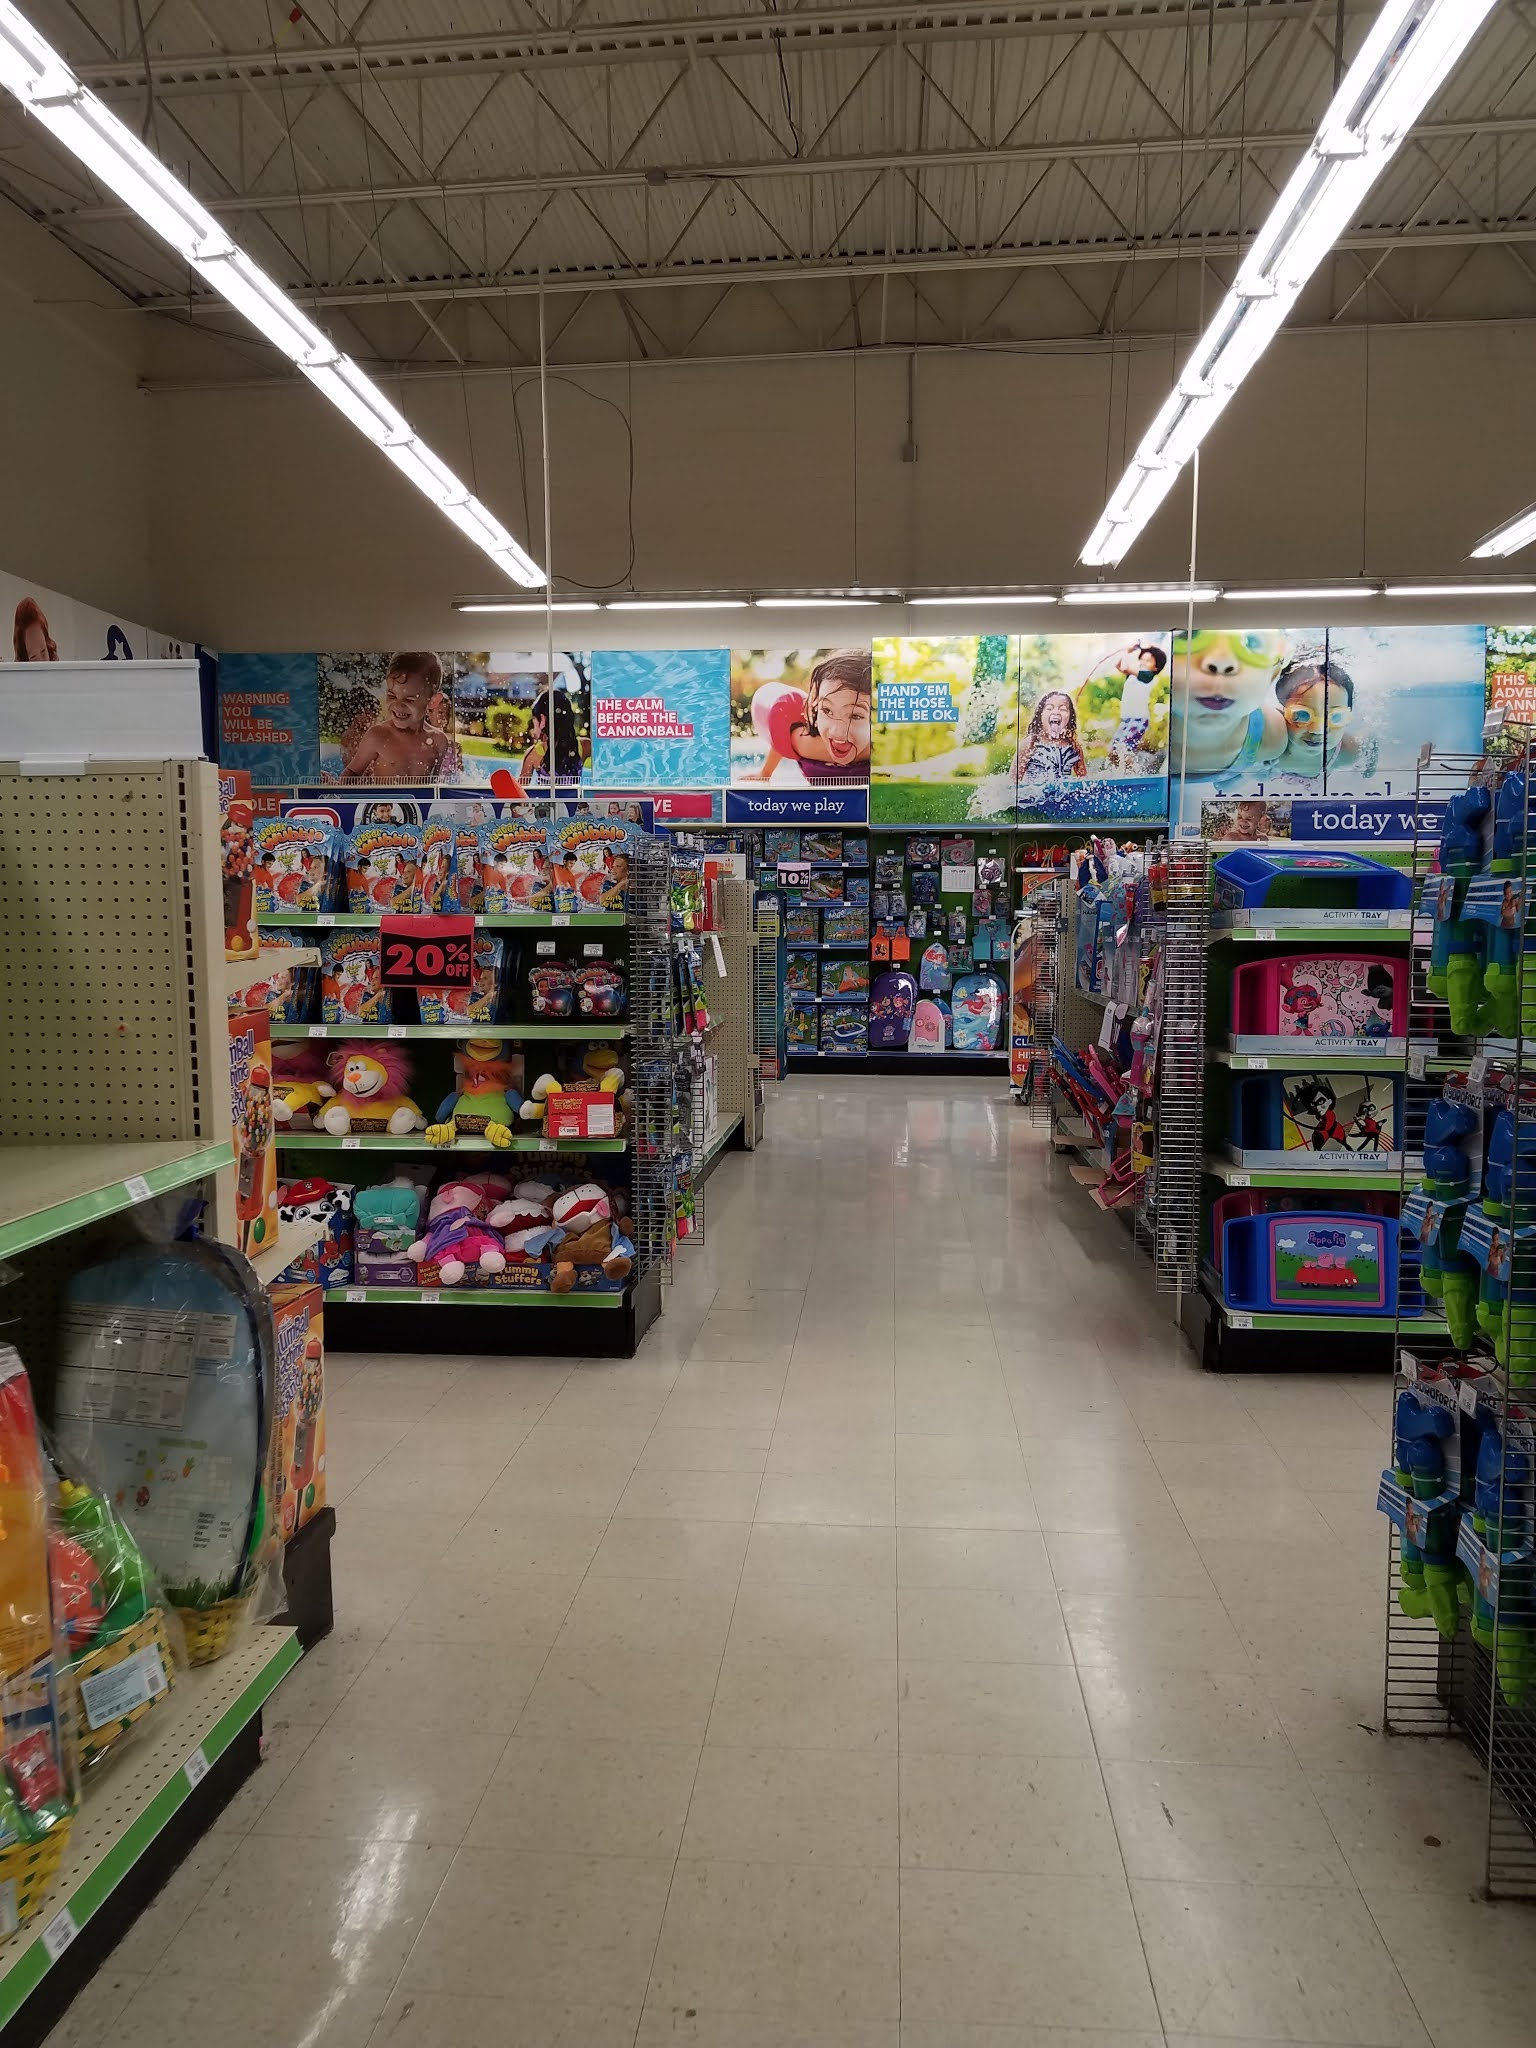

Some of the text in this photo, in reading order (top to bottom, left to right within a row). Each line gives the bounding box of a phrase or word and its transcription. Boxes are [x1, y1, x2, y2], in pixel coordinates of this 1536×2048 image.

[1494, 674, 1526, 686] THIS
[880, 684, 948, 697] HAND 'EM
[1494, 687, 1536, 698] ADVE
[222, 693, 290, 704] WARNING:
[879, 697, 950, 709] THE HOSE.
[596, 699, 663, 711] THE CALM
[223, 706, 252, 717] YOU
[879, 709, 957, 721] IT'LL BE OK.
[1503, 711, 1531, 723] AIT.
[597, 712, 677, 724] BEFORE THE
[223, 719, 273, 730] WILL BE
[223, 731, 292, 743] SPLASHED.
[597, 725, 692, 737] CANNONBALL.
[747, 797, 789, 815] today
[790, 801, 811, 812] we
[1311, 804, 1392, 836] today
[492, 826, 547, 852] Wubbl
[1323, 911, 1382, 919] ACTIVITY TRAY
[332, 935, 380, 961] Wubbl
[384, 943, 470, 977] 20%
[445, 963, 470, 977] OFF
[1314, 1038, 1354, 1046] ACTIVITY
[1318, 1152, 1356, 1160] ACTIVITY
[1309, 1231, 1345, 1246] Peppa Pig
[494, 1273, 542, 1286] Stuffers
